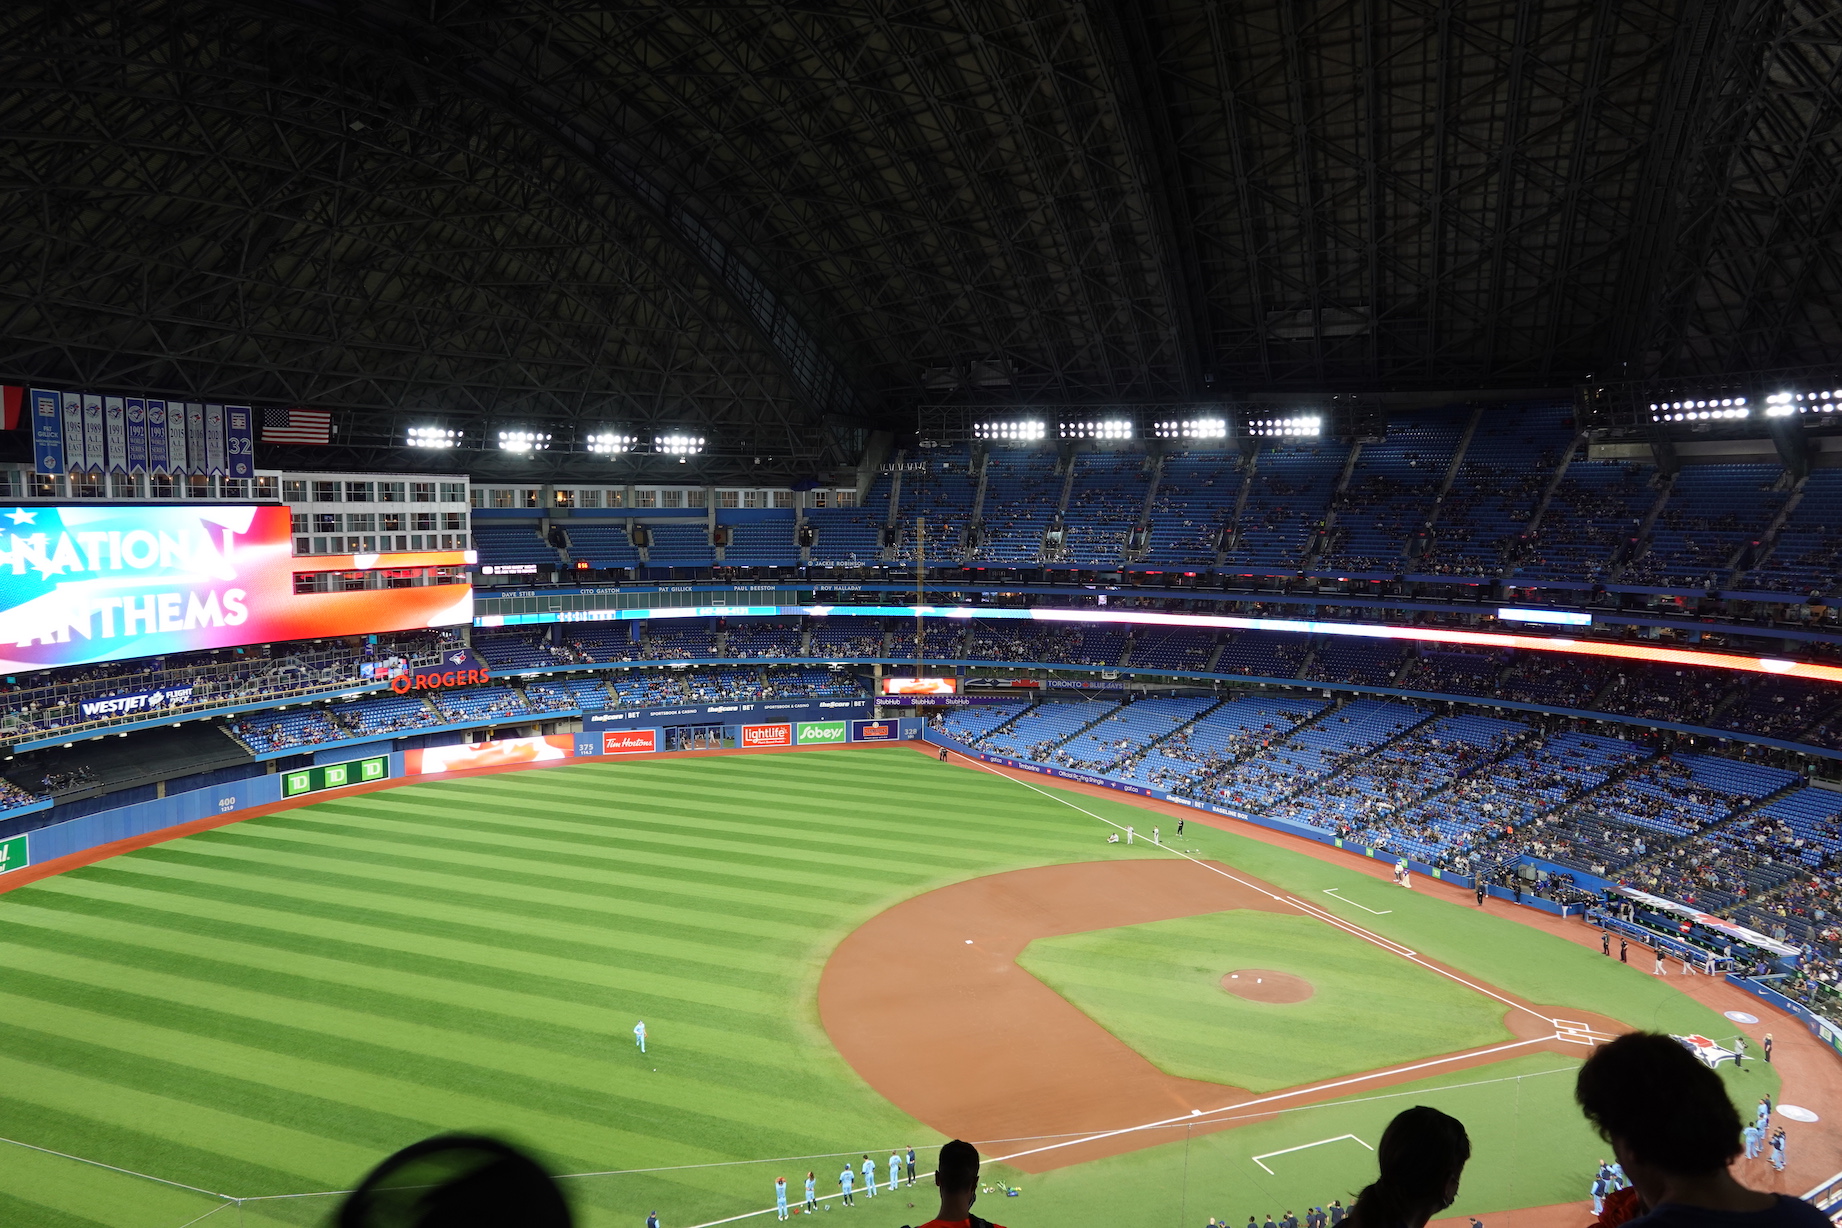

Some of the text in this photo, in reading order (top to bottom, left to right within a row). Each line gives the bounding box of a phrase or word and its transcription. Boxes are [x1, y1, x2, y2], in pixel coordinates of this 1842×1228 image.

[87, 423, 101, 433] 1989
[109, 425, 123, 435] 1991
[130, 426, 144, 436] 1992
[151, 427, 165, 437] 1993
[171, 429, 184, 438] 2015
[68, 443, 82, 451] EAST
[88, 444, 102, 452] EAST
[229, 437, 251, 454] 32
[416, 668, 490, 690] ROGERS
[1048, 680, 1082, 688] TORONTO
[166, 688, 193, 699] FLIGHT
[82, 695, 148, 715] WESTJET
[707, 704, 738, 713] theScore
[819, 701, 849, 709] theScore
[592, 714, 624, 722] theScore
[745, 727, 786, 744] Lightlife
[800, 726, 844, 740] Sobeys
[606, 737, 652, 748] Tim Hortons
[363, 762, 381, 776] TD
[326, 768, 345, 782] TD
[289, 775, 308, 790] TD
[219, 797, 236, 806] 400
[1212, 806, 1237, 818] BASELINE
